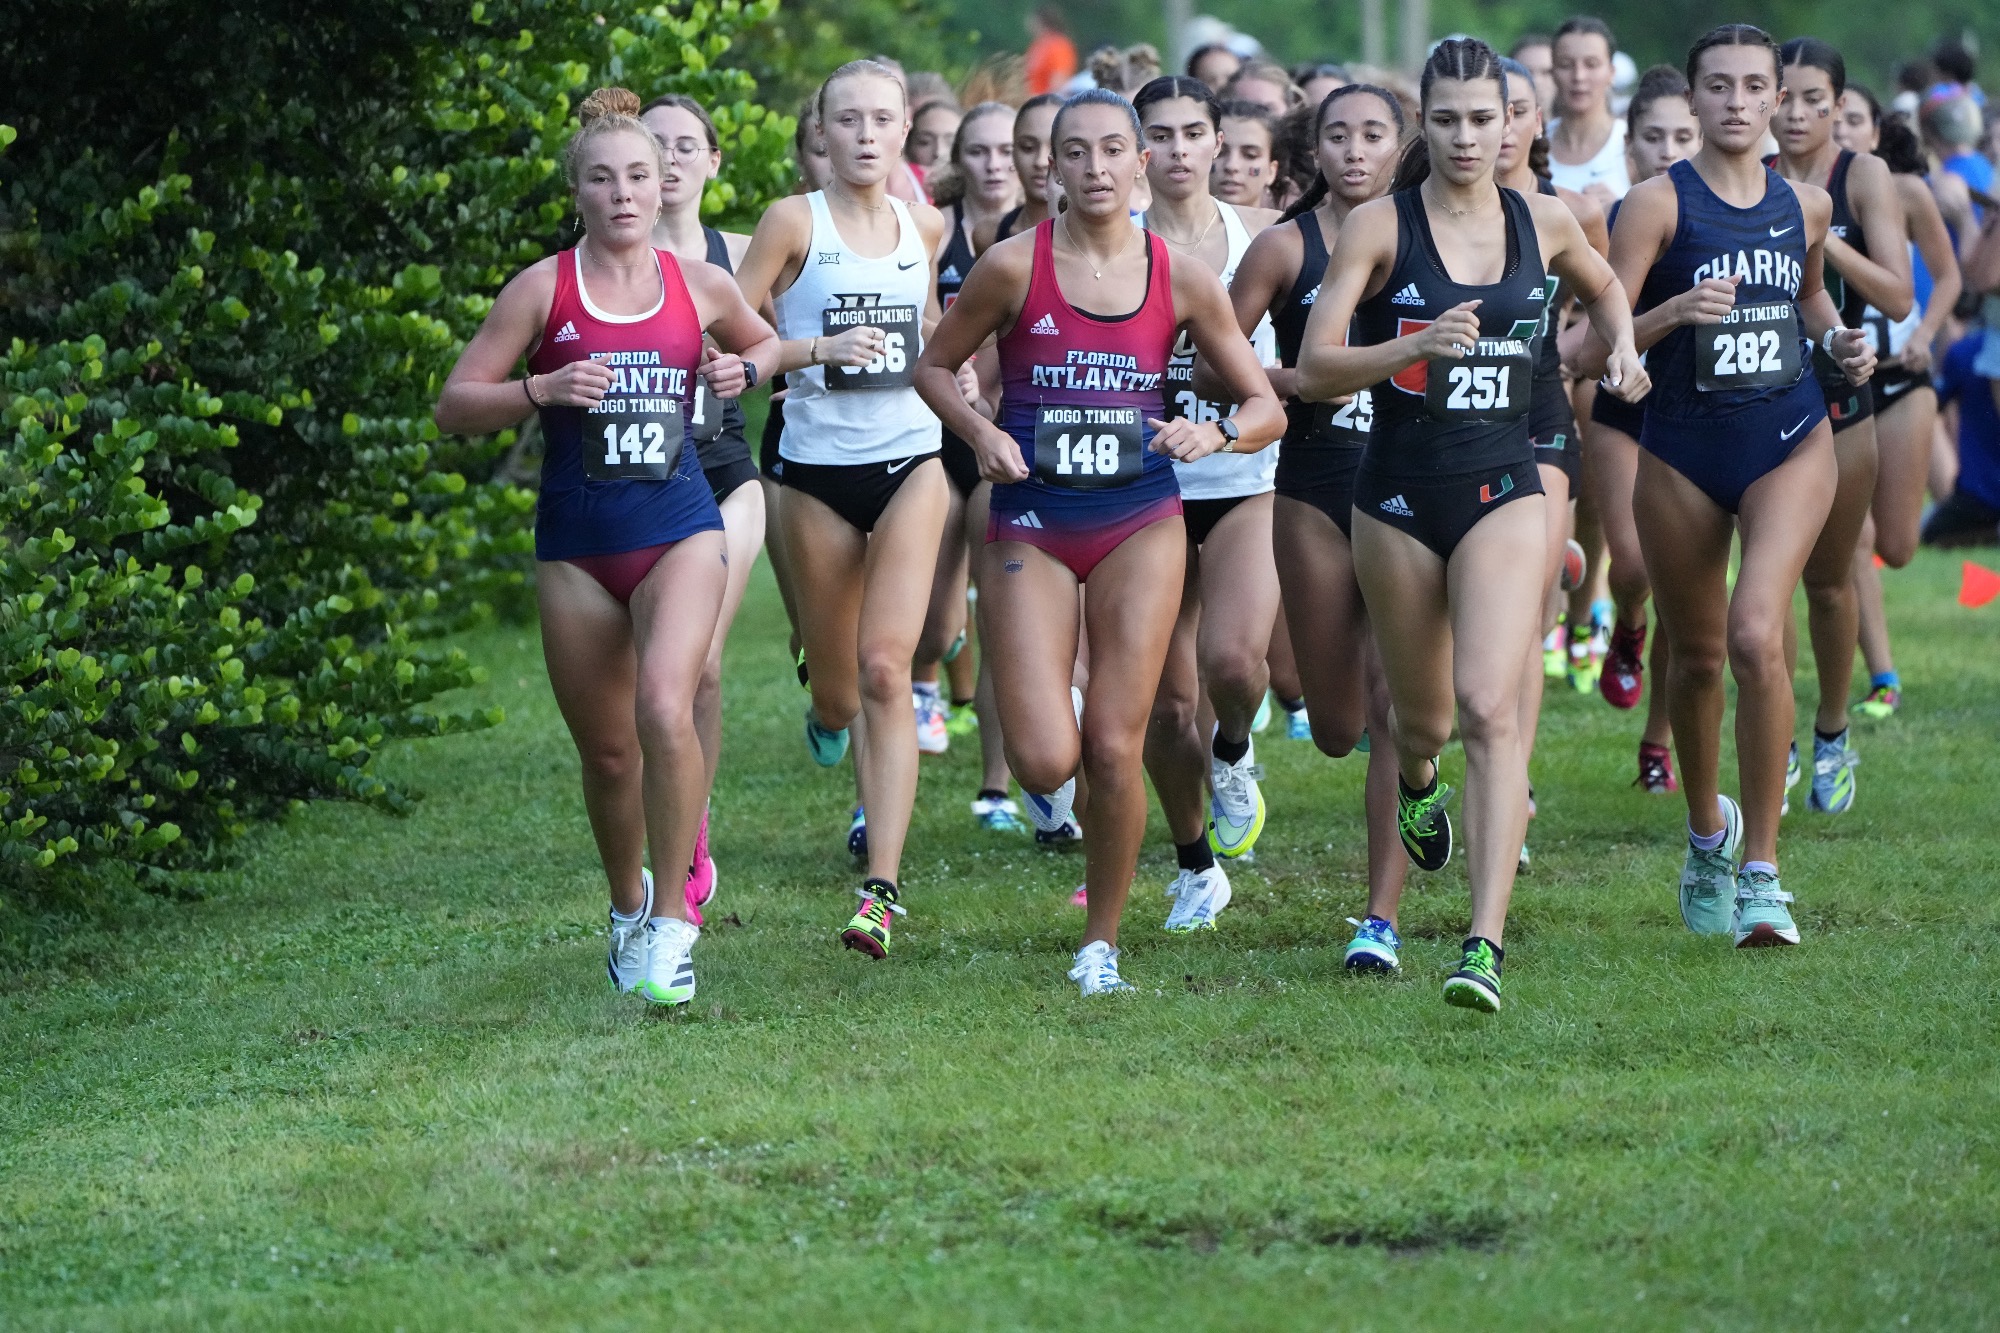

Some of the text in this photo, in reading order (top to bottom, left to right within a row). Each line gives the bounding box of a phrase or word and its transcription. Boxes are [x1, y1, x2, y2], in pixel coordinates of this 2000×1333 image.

[1391, 296, 1426, 306] adidas
[1529, 287, 1544, 297] AC
[829, 308, 912, 325] MOGO TIMING
[1743, 304, 1789, 323] TIMING
[554, 333, 581, 343] adidas
[1030, 326, 1060, 336] adidas
[1479, 339, 1524, 357] TIMING
[1713, 329, 1782, 376] 282
[1066, 350, 1137, 370] FLORIDA
[1031, 364, 1162, 392] ATLANTIC
[1446, 365, 1510, 410] 251
[629, 398, 677, 414] TIMING
[1174, 390, 1239, 424] 36
[1043, 409, 1135, 425] MOGO TIMING
[603, 422, 666, 465] 142
[1056, 433, 1120, 475] 148
[1379, 501, 1414, 517] adidas
